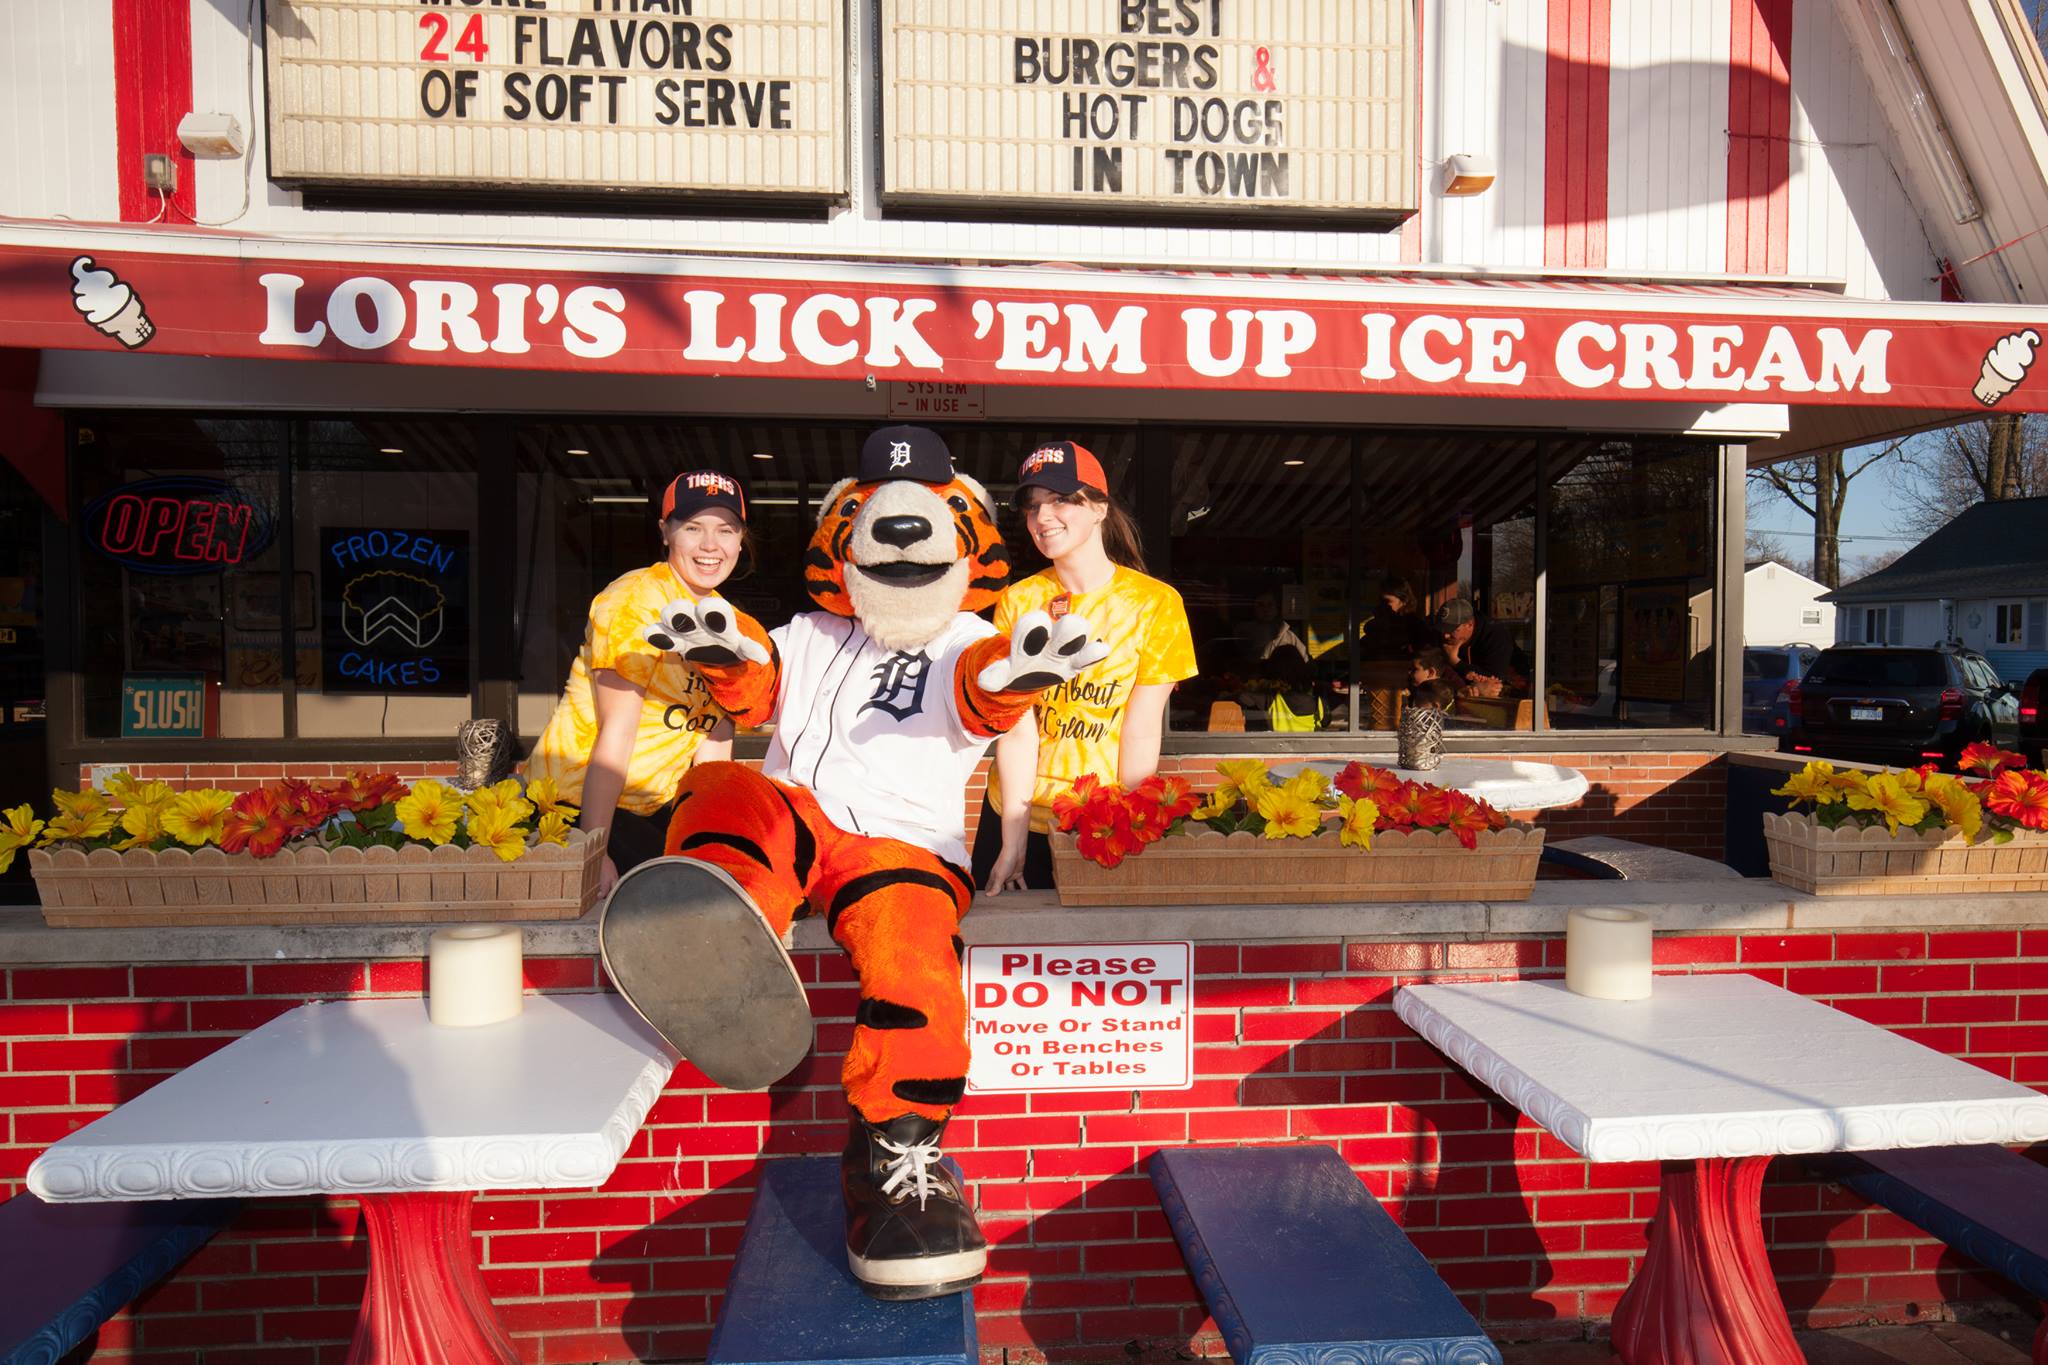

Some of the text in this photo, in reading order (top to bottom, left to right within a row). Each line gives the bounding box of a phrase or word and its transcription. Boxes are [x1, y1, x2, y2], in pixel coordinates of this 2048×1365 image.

[1120, 0, 1221, 37] BEST
[419, 12, 733, 71] 24 FLAVORS
[1015, 38, 1277, 91] BURGERS &
[421, 70, 792, 128] OF SOFT SERVE
[1063, 92, 1283, 146] HOT DOGS
[1073, 146, 1289, 197] IN TOWN
[258, 273, 1893, 394] LORI'S LICK 'EM UP ICE CREAM
[907, 382, 967, 395] SYSTEM
[915, 398, 959, 412] IN USE
[889, 441, 912, 471] D
[687, 472, 735, 496] TIGERS
[102, 495, 253, 564] OPEN
[332, 530, 455, 573] FROZEN
[339, 652, 441, 686] CAKES
[856, 649, 934, 723] D
[132, 689, 201, 730] SLUSH
[663, 703, 718, 733] Con
[1001, 953, 1157, 977] Please
[974, 979, 1183, 1009] DO NOT
[975, 1017, 1182, 1035] Move Or Stand
[993, 1039, 1164, 1055] On Benches
[1010, 1060, 1147, 1077] Or Tables
